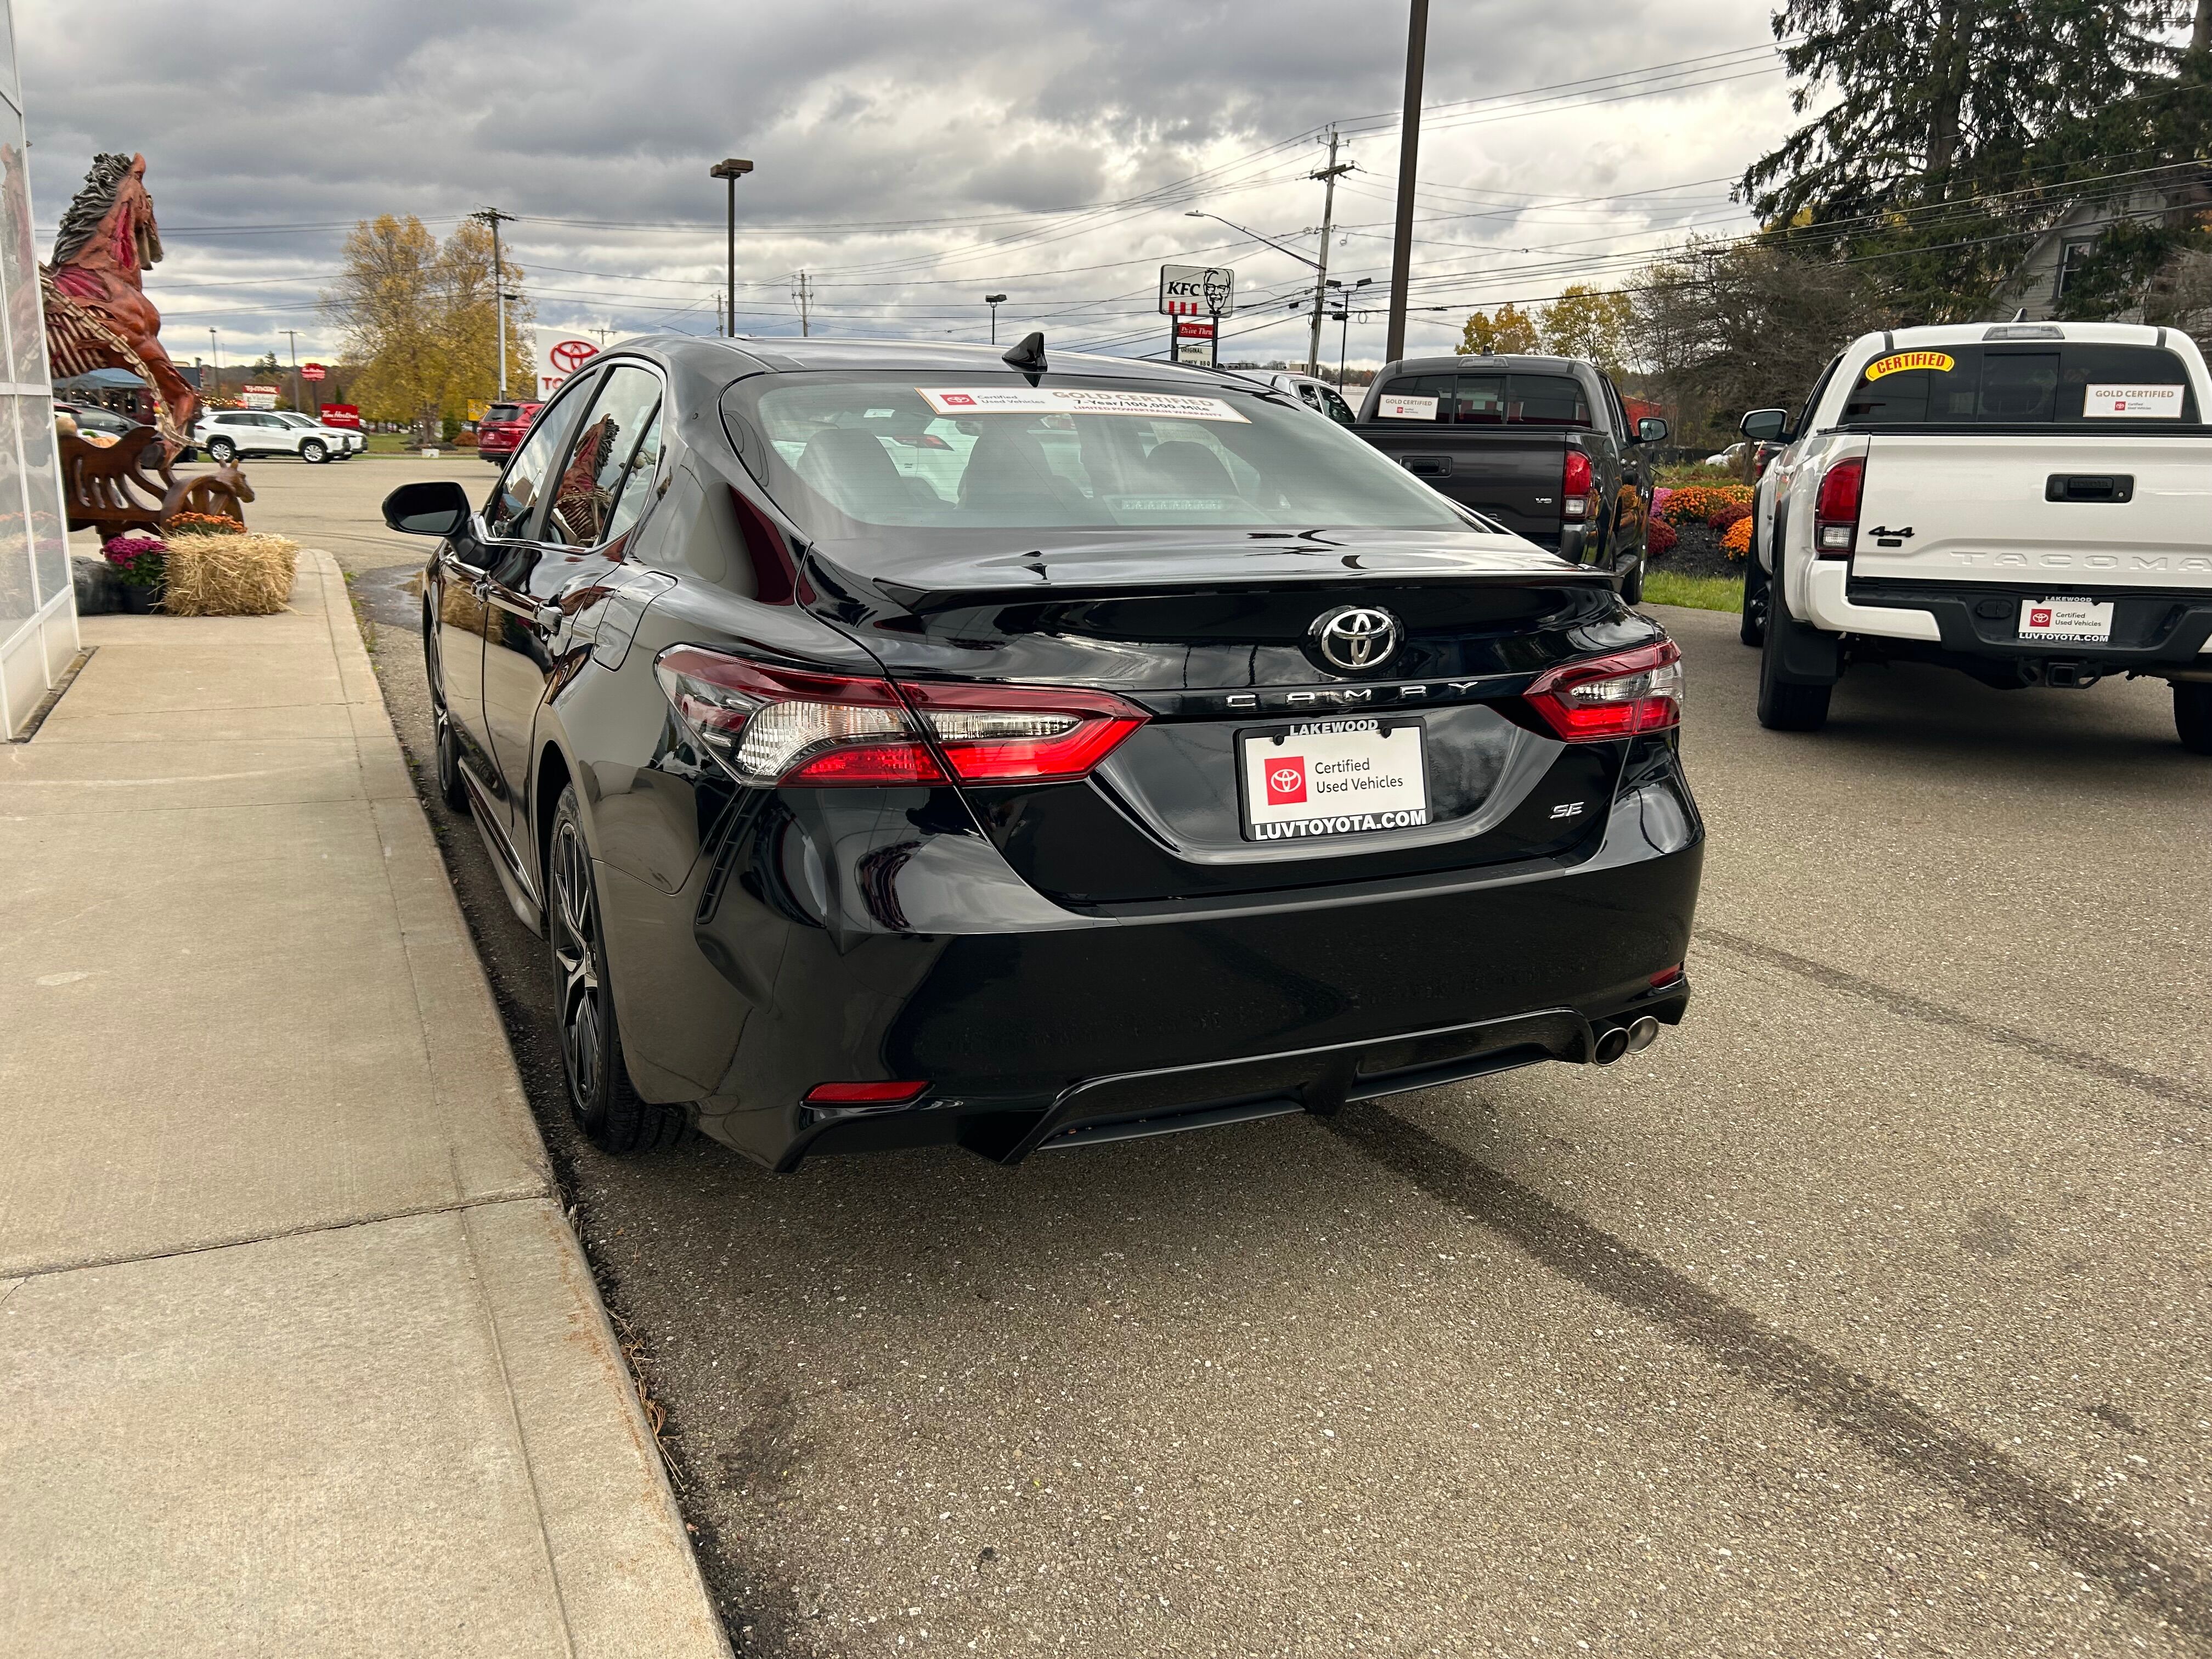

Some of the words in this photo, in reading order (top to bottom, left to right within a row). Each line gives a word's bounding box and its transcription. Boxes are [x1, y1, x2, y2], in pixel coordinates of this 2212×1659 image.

[1166, 281, 1200, 296] KFC
[1181, 326, 1198, 335] Drive
[1876, 353, 1945, 374] CERTIFIED
[1052, 391, 1112, 399] GOLD
[1115, 394, 1214, 407] CERTIFIED
[1949, 551, 2212, 572] TACOMA
[2019, 633, 2109, 642] LUVTOYOTA.COM
[1225, 681, 1479, 708] CAMRY
[1289, 720, 1378, 736] LAKEWOOD
[1315, 758, 1370, 774] Certified
[1317, 778, 1347, 793] Used
[1351, 775, 1403, 791] Vehicles
[1550, 802, 1584, 819] SE
[1254, 810, 1426, 840] LUVTOYOTA.COM
